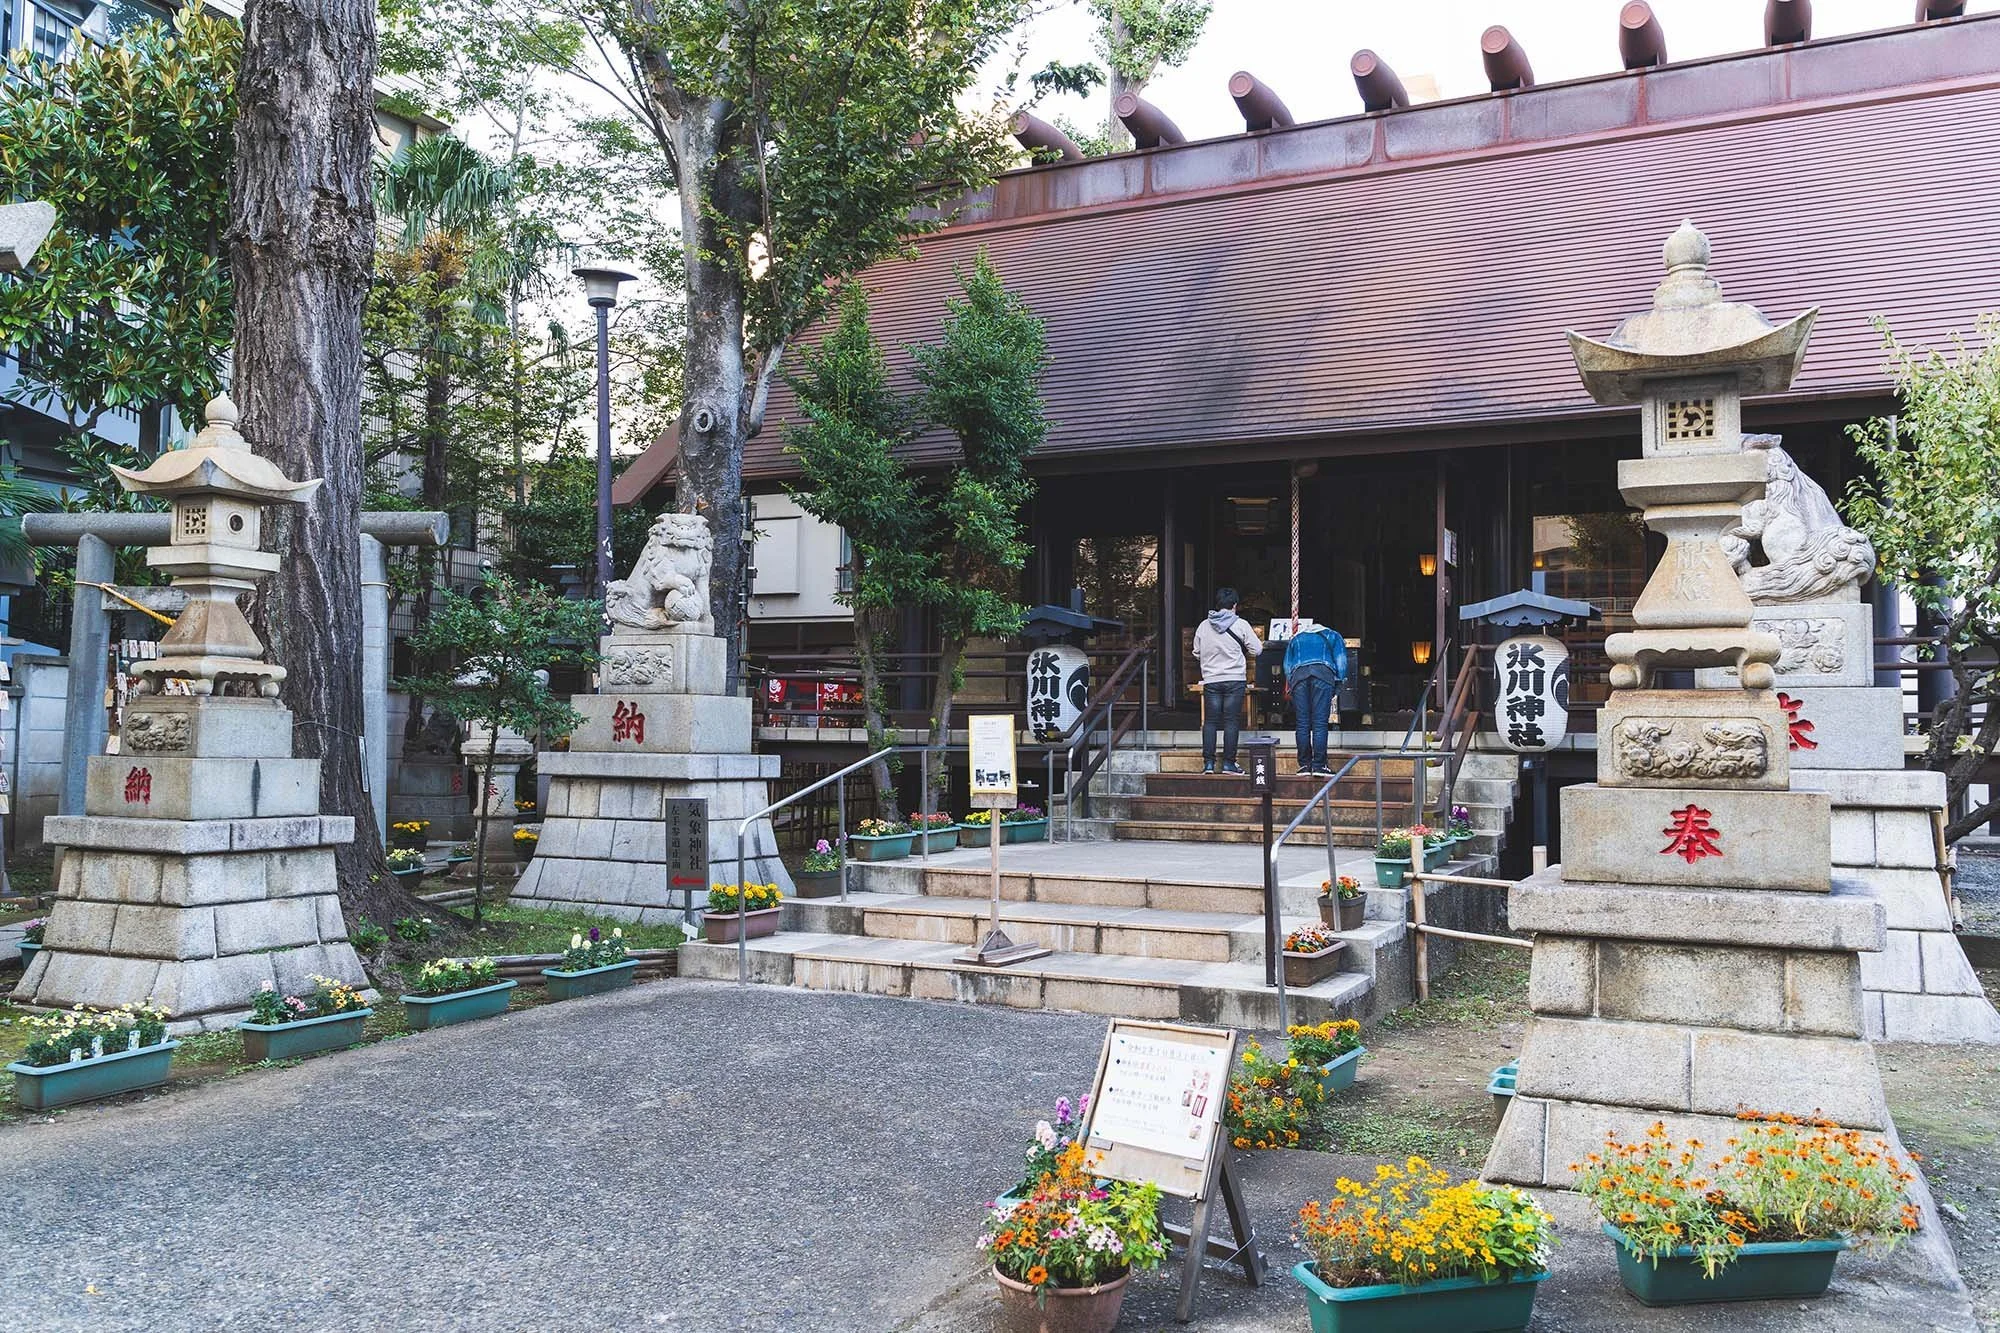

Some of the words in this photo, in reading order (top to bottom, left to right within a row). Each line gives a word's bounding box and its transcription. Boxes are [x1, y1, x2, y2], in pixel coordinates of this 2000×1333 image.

[612, 700, 645, 744] 納
[1506, 643, 1546, 747] 氷川神社
[124, 766, 152, 805] 納
[687, 802, 702, 872] 気象神社
[1659, 804, 1724, 865] 奉
